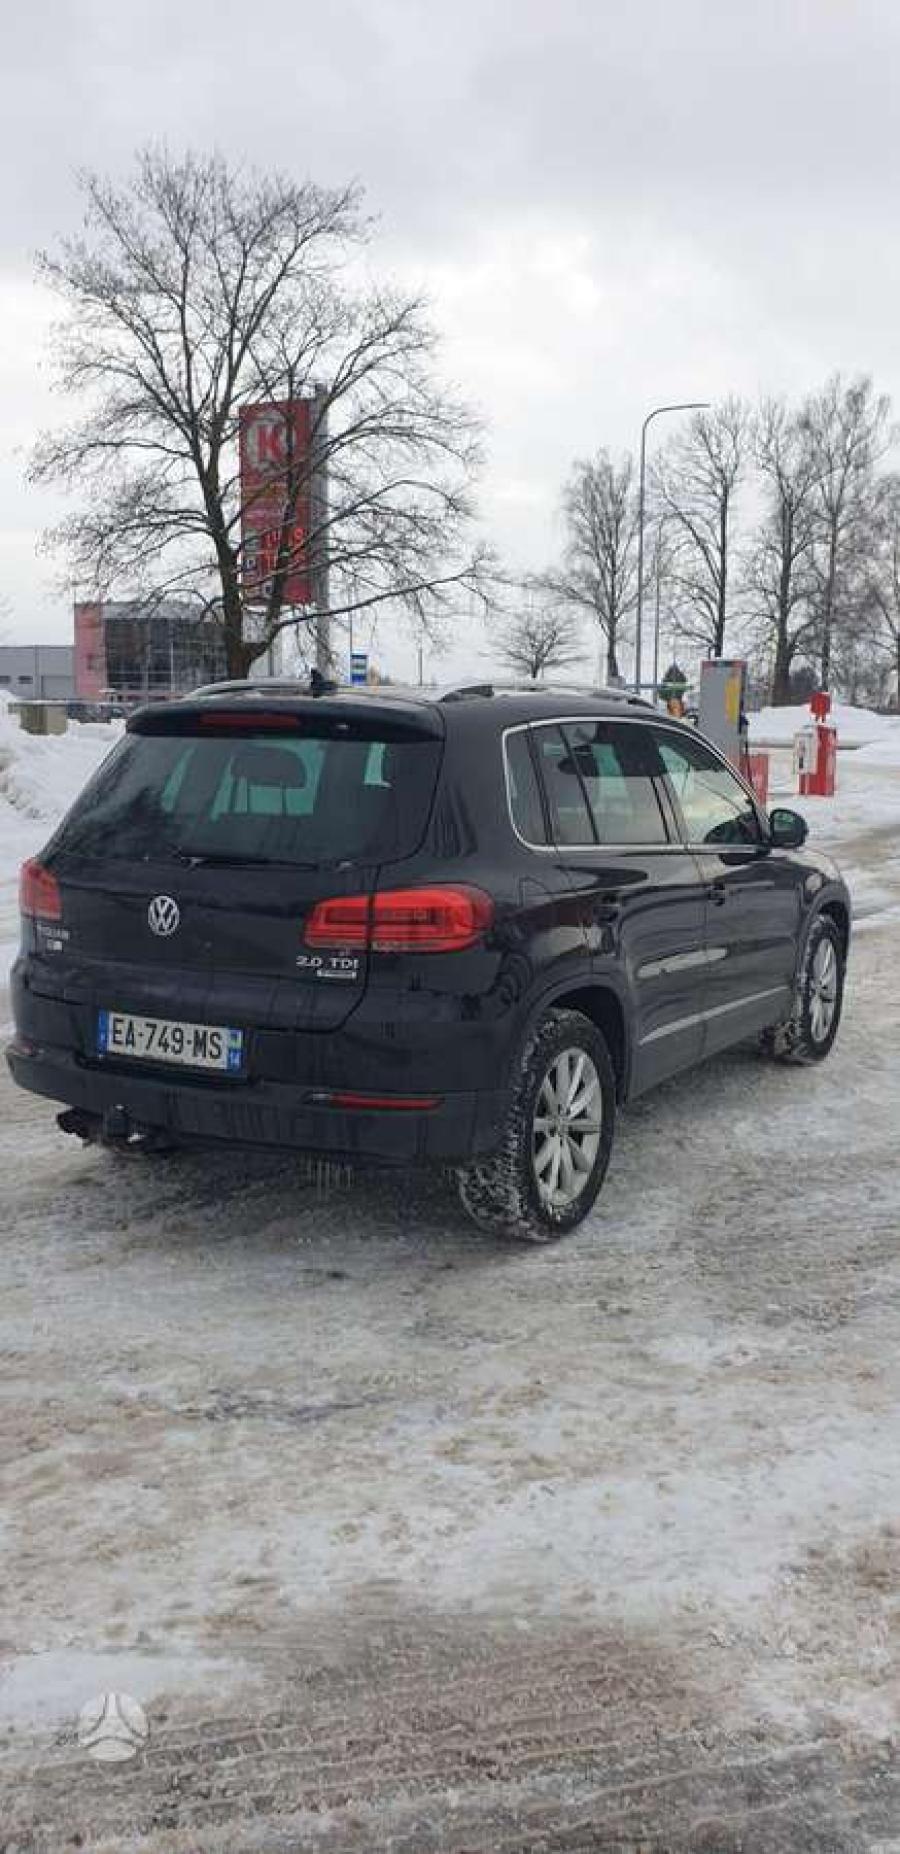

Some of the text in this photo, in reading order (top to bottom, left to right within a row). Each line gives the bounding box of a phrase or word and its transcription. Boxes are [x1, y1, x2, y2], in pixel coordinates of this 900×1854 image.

[257, 426, 283, 462] K
[296, 955, 359, 969] 2.0 TDI
[112, 1017, 222, 1060] EA-749-MS
